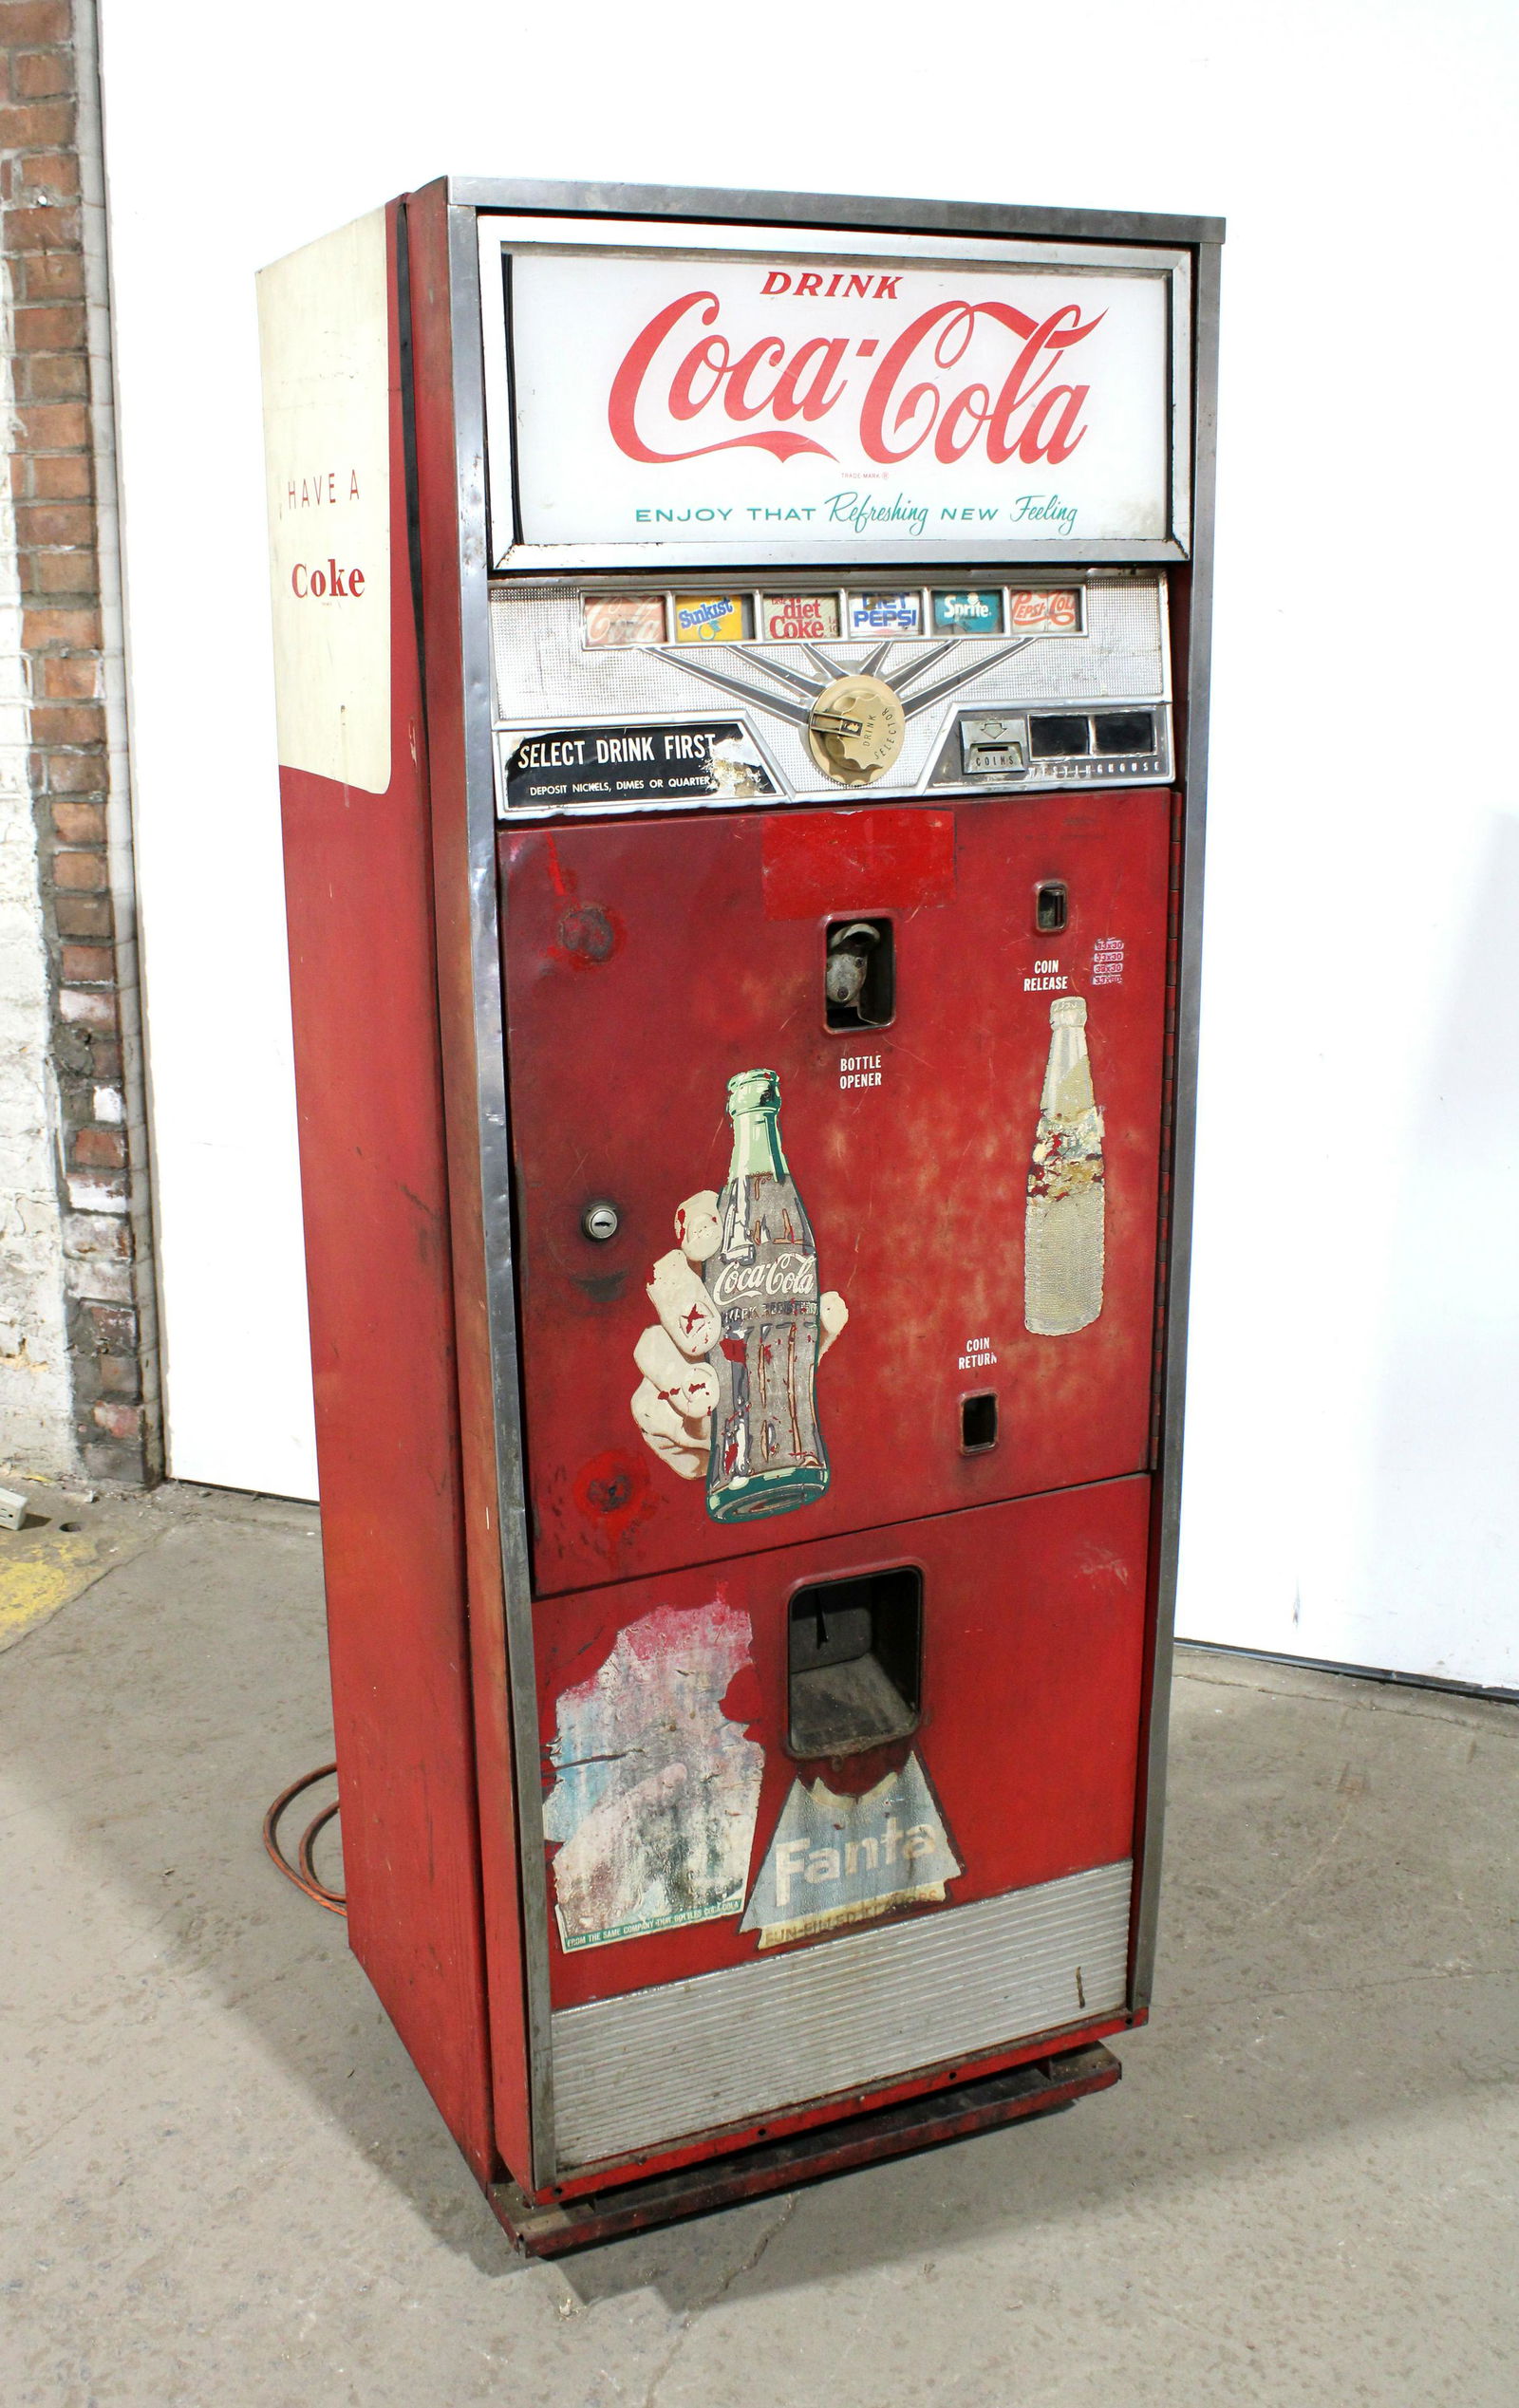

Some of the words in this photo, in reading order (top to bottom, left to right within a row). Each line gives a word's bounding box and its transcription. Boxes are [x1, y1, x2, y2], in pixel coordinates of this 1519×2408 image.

[760, 271, 904, 299] DRINK
[609, 291, 1109, 464] Coca-Cola
[288, 473, 336, 510] HAVE
[349, 469, 360, 500] A
[636, 508, 732, 523] ENJOY
[747, 507, 816, 522] THAT
[824, 491, 929, 536] Refreshing
[941, 507, 1001, 521] NEW
[1009, 495, 1078, 534] Feeling
[291, 558, 366, 598] Coke
[783, 596, 822, 620] diet
[862, 592, 910, 609] DIET
[944, 593, 989, 623] Sprite
[678, 598, 734, 629] Sunkist
[853, 609, 917, 627] PEPSI
[770, 615, 825, 640] Coke
[863, 715, 877, 747] DRINK
[874, 707, 897, 759] SELECTOR
[518, 741, 586, 769] SELECT
[597, 737, 656, 764] DRINK
[665, 733, 716, 760] FIRST
[976, 756, 1015, 767] COINS
[1028, 761, 1160, 777] WESTINGHOUSE
[530, 785, 568, 796] DEPOSIT
[572, 781, 612, 793] NICKELS,
[616, 779, 645, 791] DIMES
[649, 779, 664, 789] OR
[1035, 960, 1060, 974] COIN
[1023, 976, 1069, 992] RELEASE
[840, 1055, 882, 1072] BOTTLE
[839, 1073, 882, 1090] OPENER
[713, 1252, 817, 1305] Coca-Cola
[966, 1336, 990, 1353] COIN
[958, 1353, 998, 1370] RETURN
[776, 1817, 936, 1907] Fanta
[567, 1935, 587, 1948] FROM
[588, 1932, 602, 1943] THE
[603, 1928, 622, 1939] SAME
